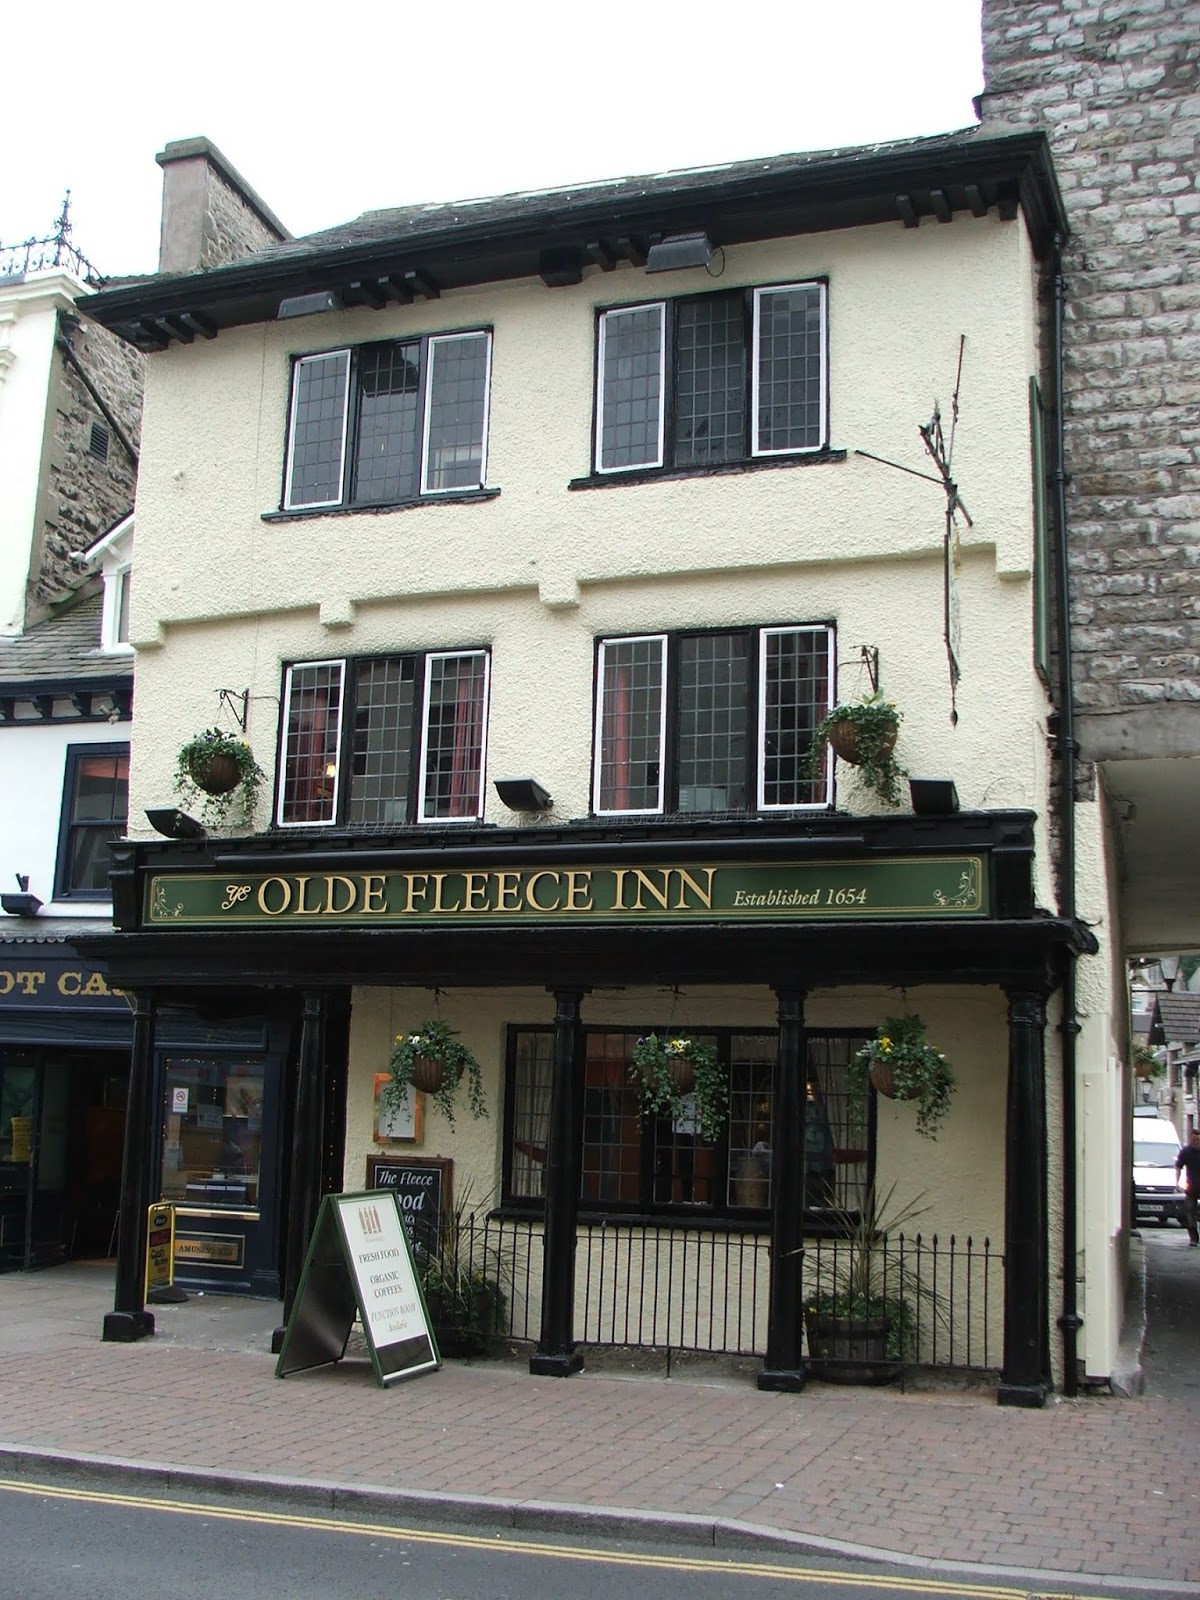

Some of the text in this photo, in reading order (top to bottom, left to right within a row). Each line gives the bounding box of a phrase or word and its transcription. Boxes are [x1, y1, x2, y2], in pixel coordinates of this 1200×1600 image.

[257, 875, 389, 916] OLDE
[401, 870, 594, 914] FLEECE
[609, 867, 719, 911] INN
[732, 888, 821, 907] Established
[826, 887, 868, 905] 1654
[57, 971, 128, 997] CA
[378, 1170, 434, 1186] The Fleece
[397, 1191, 426, 1211] od
[358, 1248, 400, 1264] FRESH FOOD
[369, 1270, 399, 1285] ORGANIC
[374, 1284, 403, 1298] COFFEES
